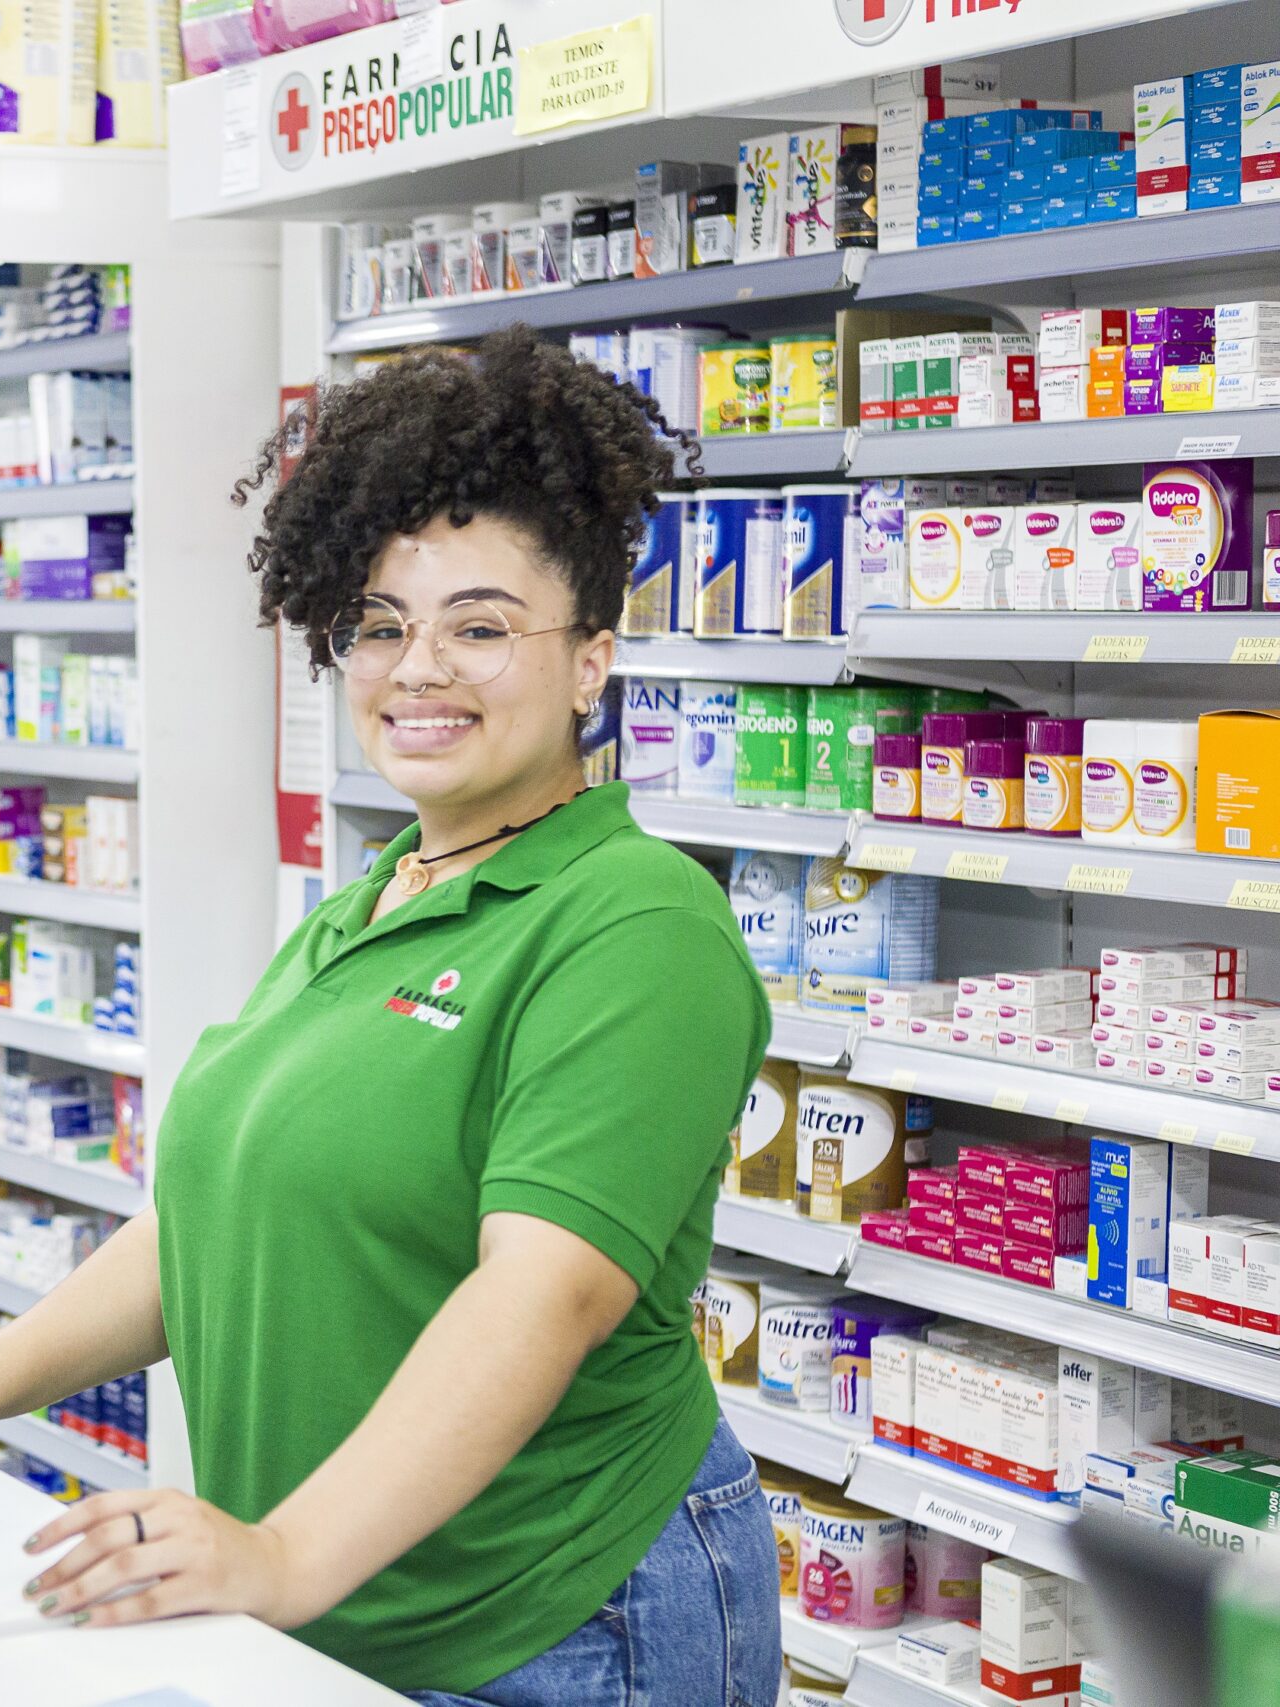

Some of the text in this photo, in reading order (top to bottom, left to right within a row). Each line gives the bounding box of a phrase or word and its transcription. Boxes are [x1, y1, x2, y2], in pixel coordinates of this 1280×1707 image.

[564, 40, 605, 64] TEMOS
[323, 23, 513, 103] FARCIA
[548, 59, 620, 89] AUTO-TESTE
[1268, 69, 1280, 78] Plu
[1138, 86, 1176, 99] Ablok Plus
[1045, 324, 1077, 332] acheflan
[895, 341, 921, 350] ACERTIL
[929, 338, 955, 347] ACERTIL
[962, 336, 993, 345] ACERTIL
[1001, 334, 1032, 344] ACERTIL
[863, 344, 888, 353] ACERTIL
[1044, 380, 1075, 388] acheflan
[1153, 490, 1196, 505] Addera
[1027, 518, 1050, 529] Addera
[1091, 516, 1115, 527] Addera
[1092, 637, 1133, 647] ADDERA
[1236, 652, 1273, 661] FLASH
[686, 710, 735, 728] egomin
[736, 715, 798, 734] STOGENO
[817, 741, 831, 770] 2
[963, 854, 1000, 866] ADDERA
[951, 866, 1001, 880] VITAMINAS
[1075, 866, 1116, 878] ADDERA
[1066, 879, 1113, 892] VITAMINA
[1246, 882, 1280, 895] ADDER
[1235, 896, 1280, 910] MUSCUL
[800, 1104, 865, 1135] utren
[1212, 1254, 1230, 1265] AD-TIL
[1248, 1262, 1266, 1273] AD-TIL
[1063, 1363, 1092, 1382] affer
[1269, 1491, 1279, 1512] 500
[926, 1501, 1003, 1540] Aerolin spray
[802, 1517, 865, 1544] STAGEN
[1177, 1511, 1245, 1553] Água
[809, 1568, 824, 1585] 26
